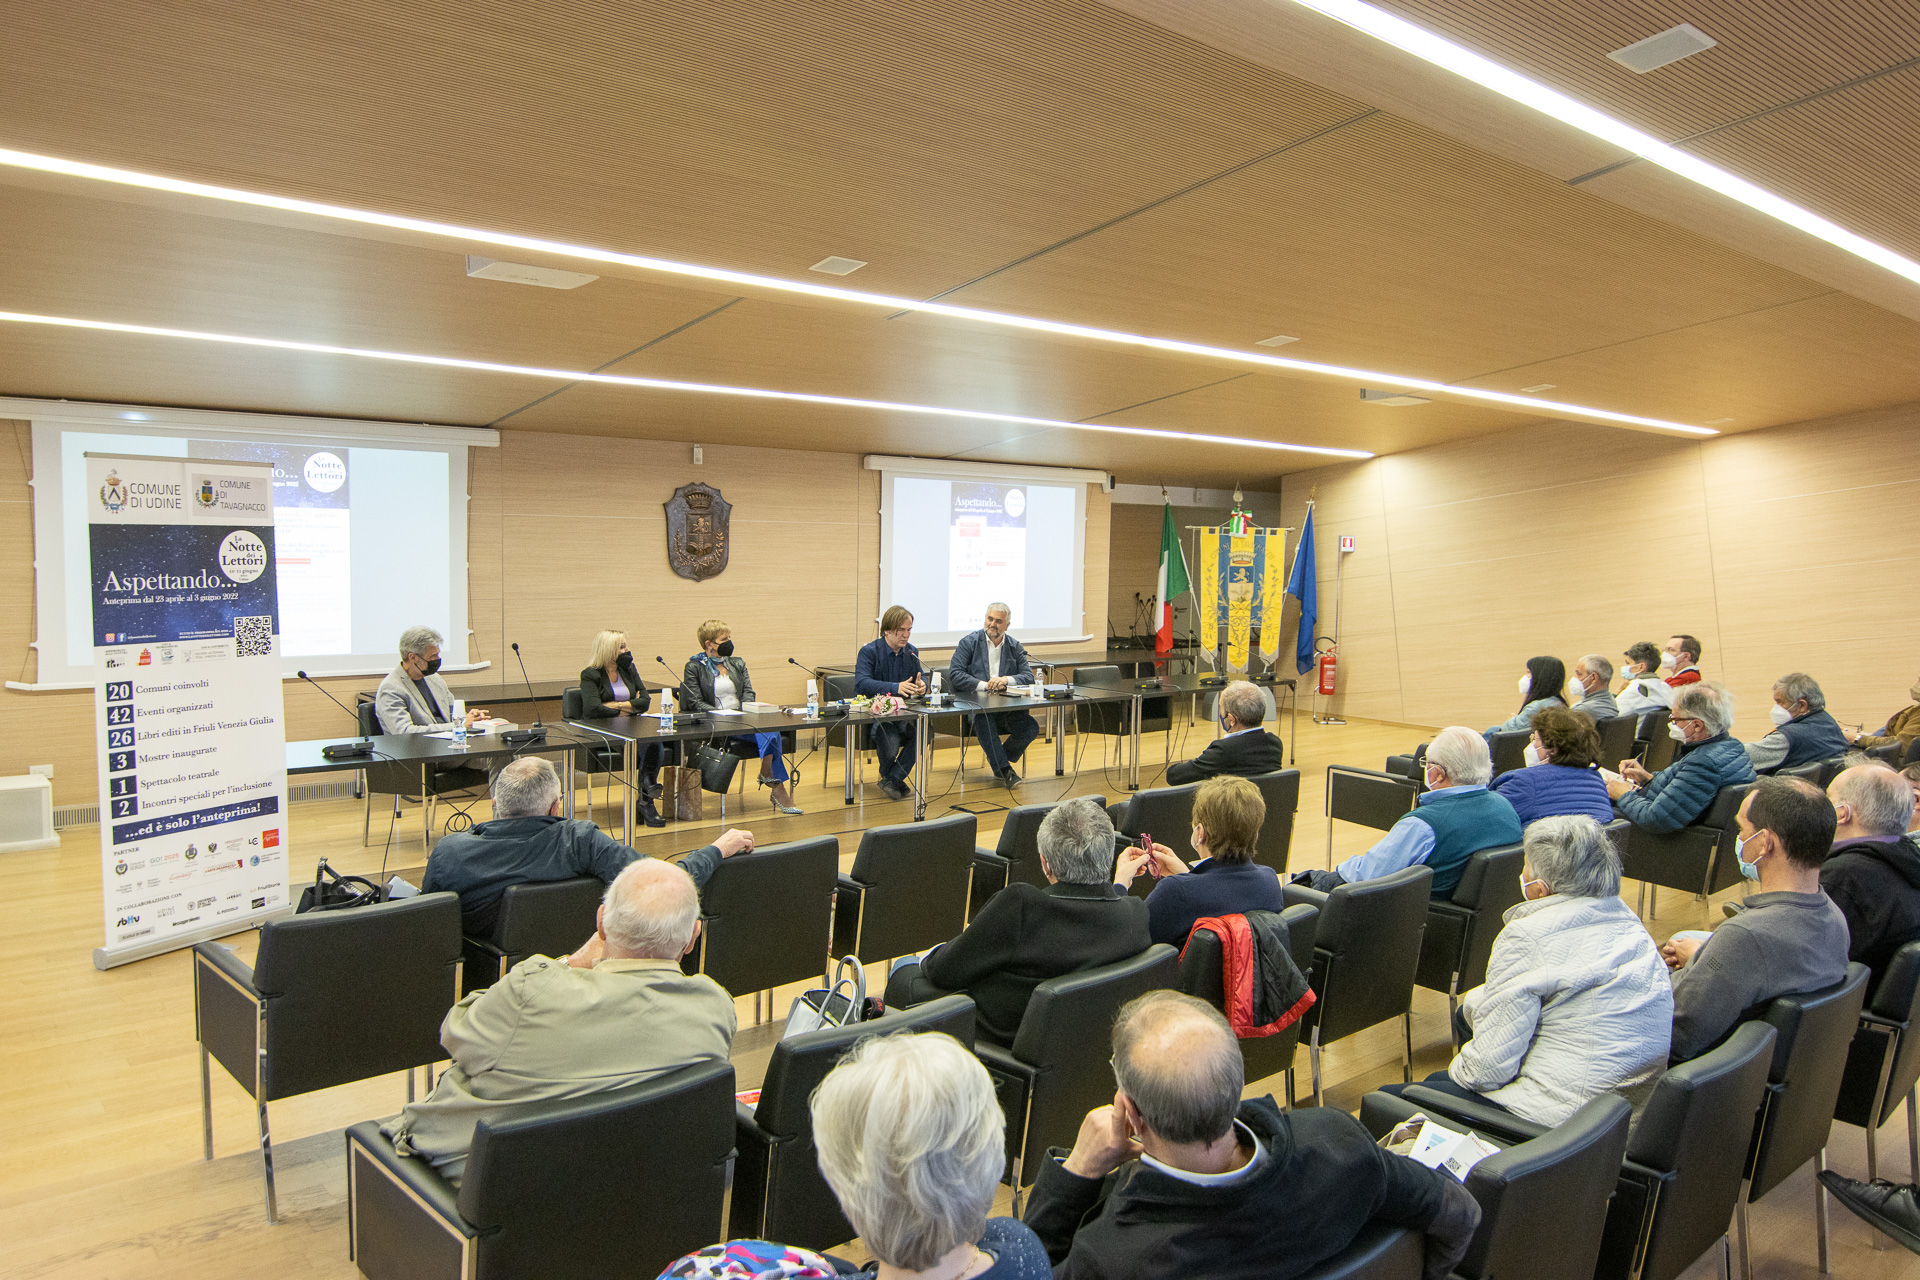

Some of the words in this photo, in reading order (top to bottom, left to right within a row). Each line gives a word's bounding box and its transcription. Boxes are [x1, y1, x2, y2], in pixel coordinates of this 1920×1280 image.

[130, 482, 181, 496] COMUNE
[220, 480, 251, 490] COMUNE
[131, 497, 145, 508] DI
[146, 497, 182, 510] UDINE
[220, 502, 266, 512] TAVAGNACCO
[228, 541, 262, 552] Notte
[222, 554, 264, 566] Lettori
[102, 568, 238, 596] Aspettando...
[102, 597, 142, 606] Anteprima
[155, 595, 164, 603] 23
[166, 594, 185, 604] aprile
[200, 594, 222, 602] giugno
[108, 684, 130, 700] 20
[136, 683, 172, 694] Comuni
[173, 680, 210, 691] coinvolti
[110, 707, 131, 723] 42
[136, 706, 165, 717] Eventi
[166, 701, 214, 714] organizzati
[110, 730, 132, 746] 26
[138, 730, 160, 740] Libri
[162, 728, 181, 738] editi
[183, 726, 192, 735] in
[194, 722, 216, 734] Friuli
[218, 720, 248, 730] Venezia
[249, 716, 274, 726] Giulia
[116, 754, 128, 768] 3
[138, 752, 170, 764] Mostre
[172, 746, 218, 760] inaugurate
[119, 779, 128, 794] 1
[140, 774, 187, 788] Spettacolo
[188, 769, 220, 780] teatrale
[119, 801, 130, 816] 2
[142, 798, 177, 809] Incontri
[178, 789, 211, 804] speciali
[212, 788, 226, 799] per
[126, 822, 154, 838] ...ed
[156, 819, 163, 832] è
[165, 817, 190, 830] solo
[114, 847, 140, 856] PARTNER
[124, 895, 170, 910] COLLABORAZIONE
